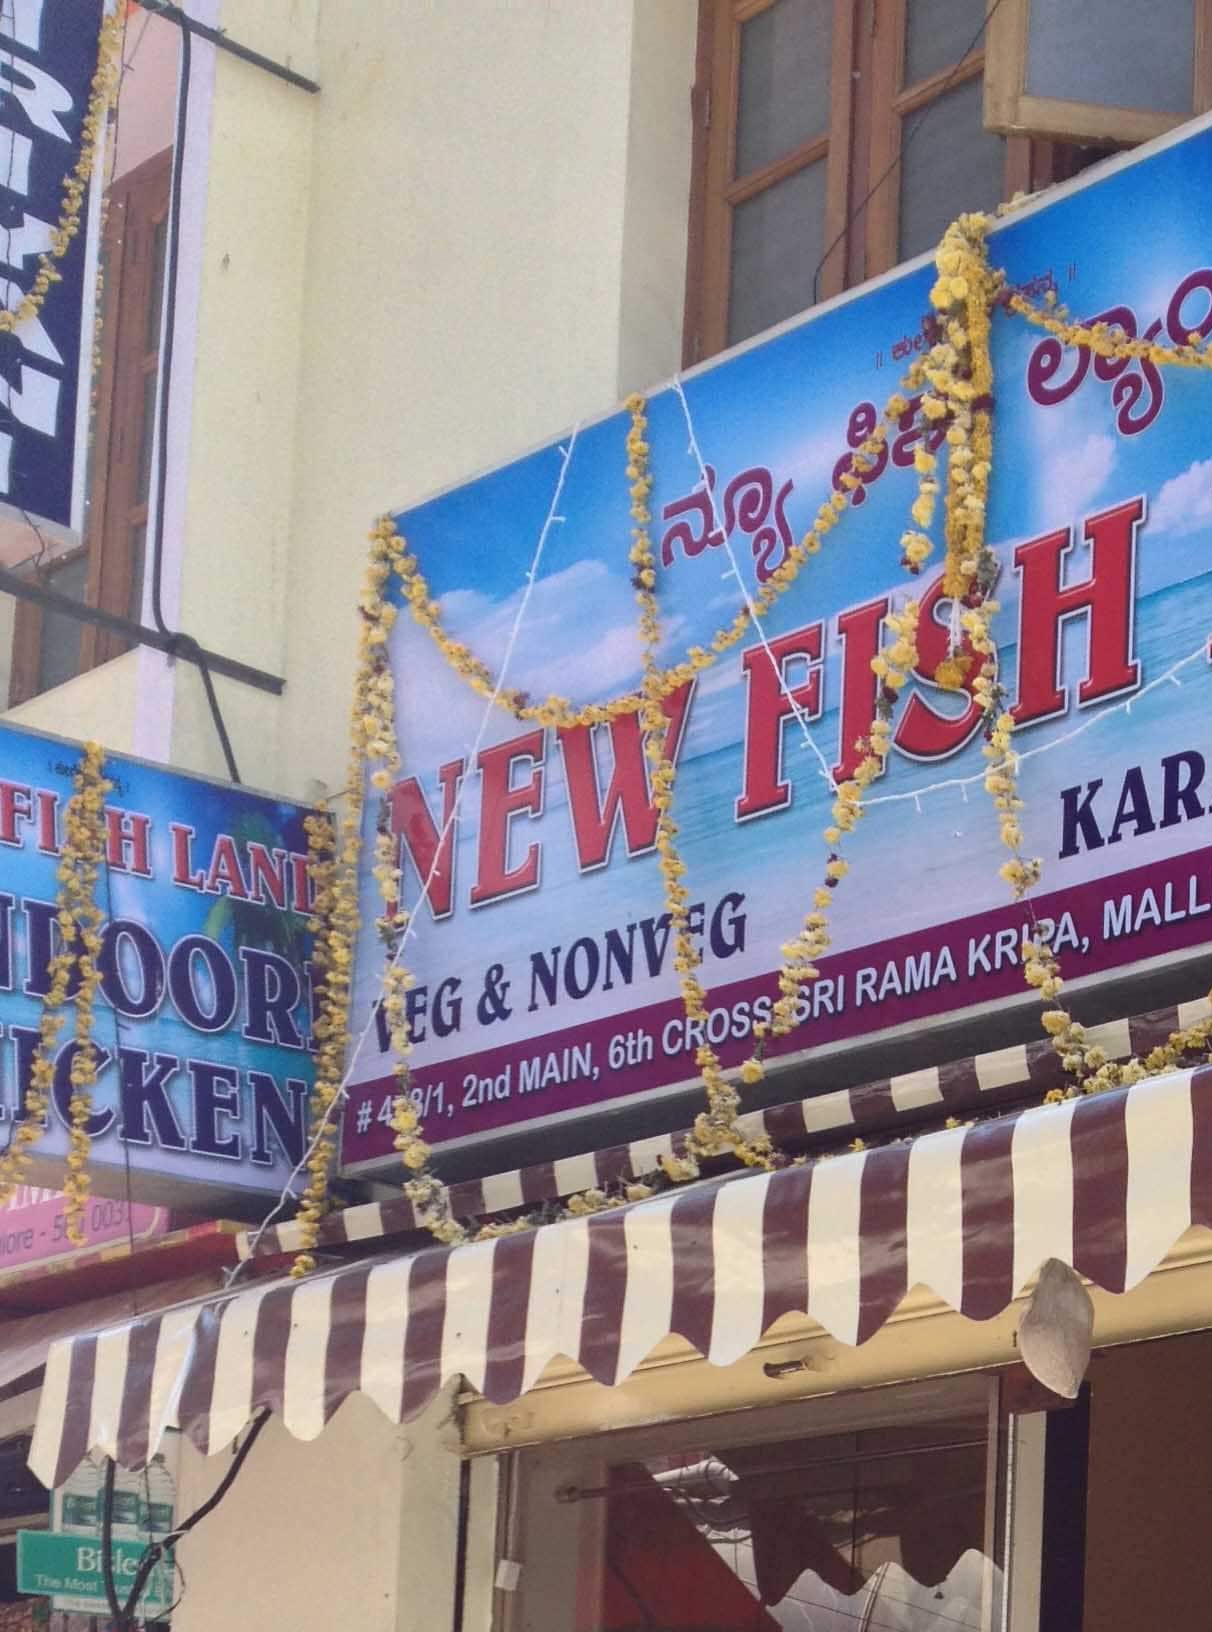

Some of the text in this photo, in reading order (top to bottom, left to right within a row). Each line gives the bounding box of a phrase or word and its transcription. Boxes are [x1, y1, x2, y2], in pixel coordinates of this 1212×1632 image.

[382, 678, 698, 930] NEW
[734, 497, 1144, 823] FISH
[0, 778, 153, 879] FIH
[376, 1081, 455, 1124] 48/1,
[462, 1062, 512, 1109] 2nd
[518, 1042, 600, 1095] MAIN,
[607, 1028, 655, 1072] 6th
[794, 977, 845, 1023] SRI
[854, 945, 958, 1008] RAMA
[967, 911, 1091, 978] KRIPA,
[476, 962, 513, 1027] &
